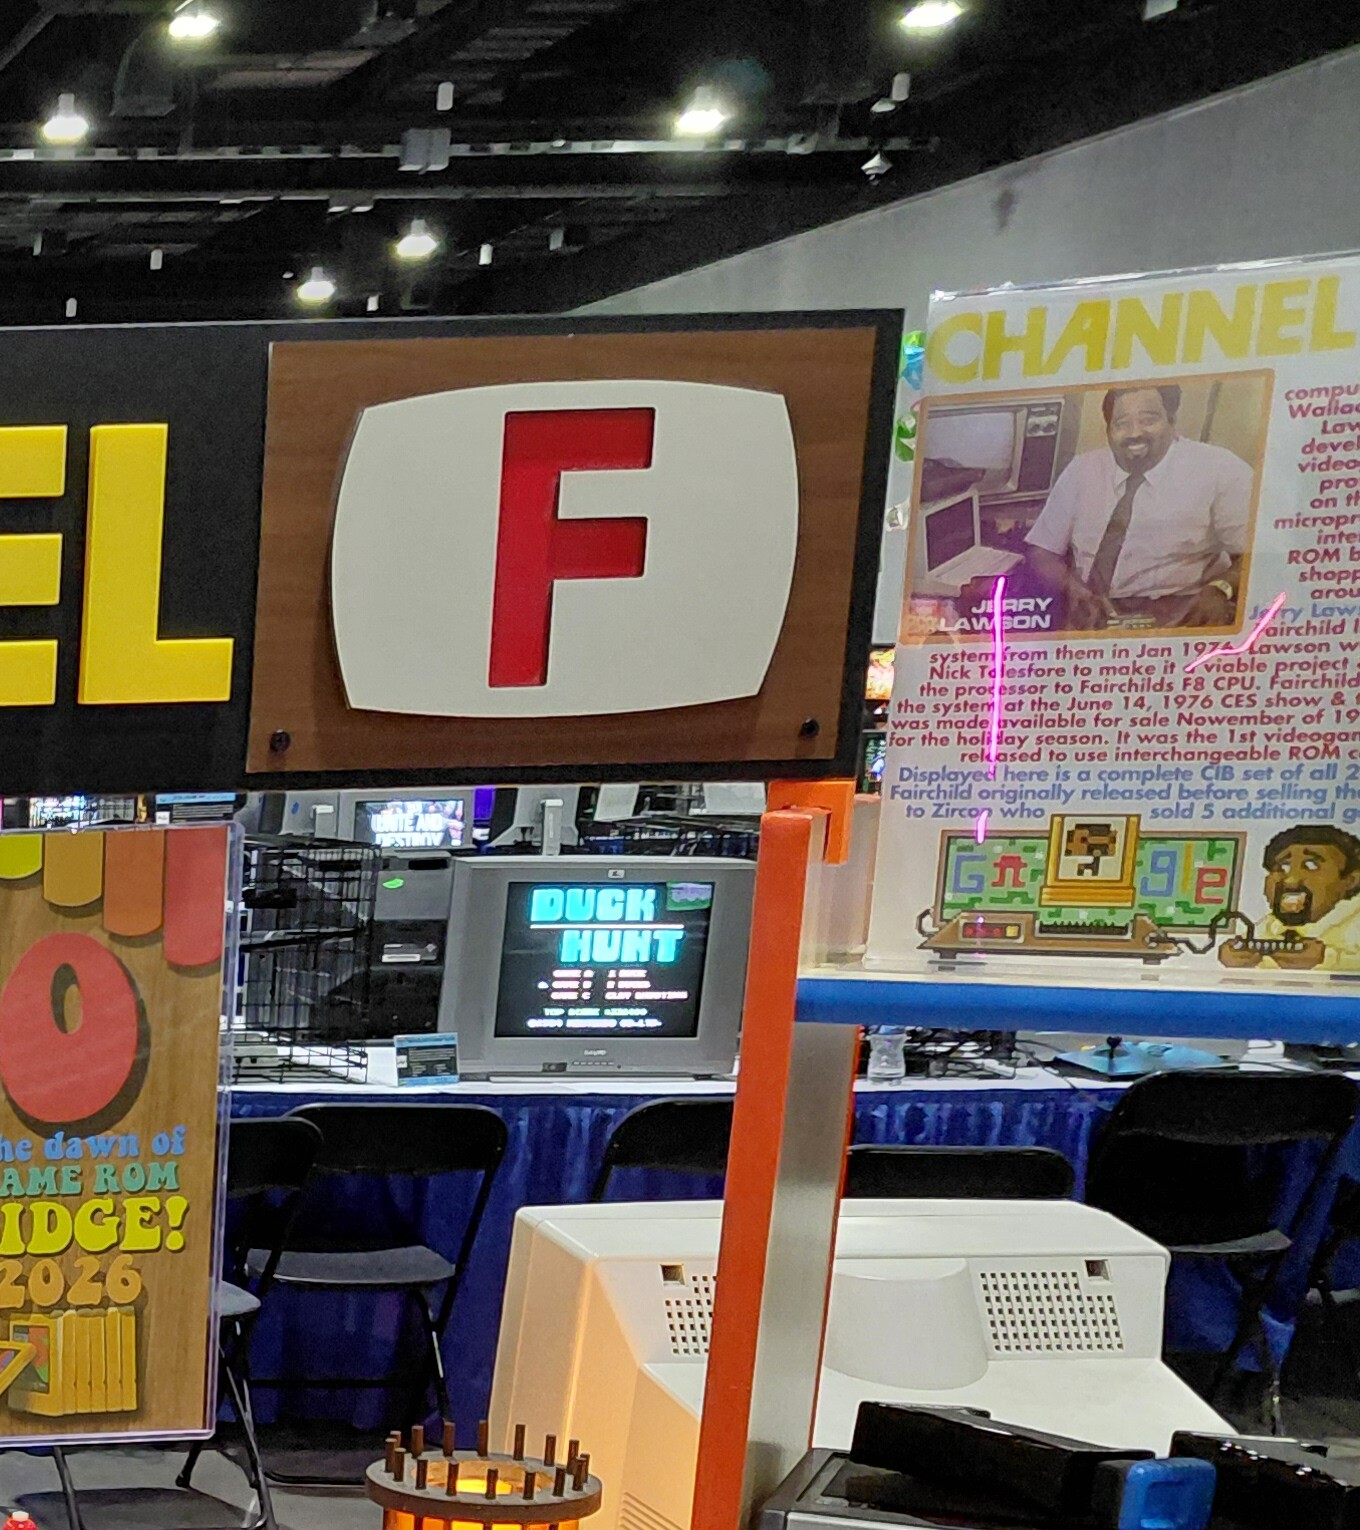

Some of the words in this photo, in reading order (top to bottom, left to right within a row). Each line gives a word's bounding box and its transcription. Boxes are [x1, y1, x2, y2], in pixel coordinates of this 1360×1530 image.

[926, 276, 1355, 384] CHANNEL
[488, 407, 655, 688] F
[1205, 658, 1267, 674] viable
[1275, 656, 1348, 677] project
[1183, 677, 1205, 691] F8
[1214, 676, 1261, 691] CPU.
[1067, 696, 1112, 711] June
[1164, 694, 1214, 710] 1976
[1221, 693, 1257, 708] CES
[1265, 691, 1323, 708] show
[1177, 710, 1294, 726] Nowember
[1036, 733, 1109, 745] season.
[1115, 743, 1281, 765] interchangeable
[1098, 765, 1194, 786] complete
[1180, 784, 1248, 800] before
[1256, 783, 1328, 804] selling
[531, 888, 656, 922] DUCK
[560, 930, 685, 962] HUNT
[44, 1132, 139, 1160] dawn
[152, 1125, 188, 1156] of
[94, 1161, 181, 1194] ROM
